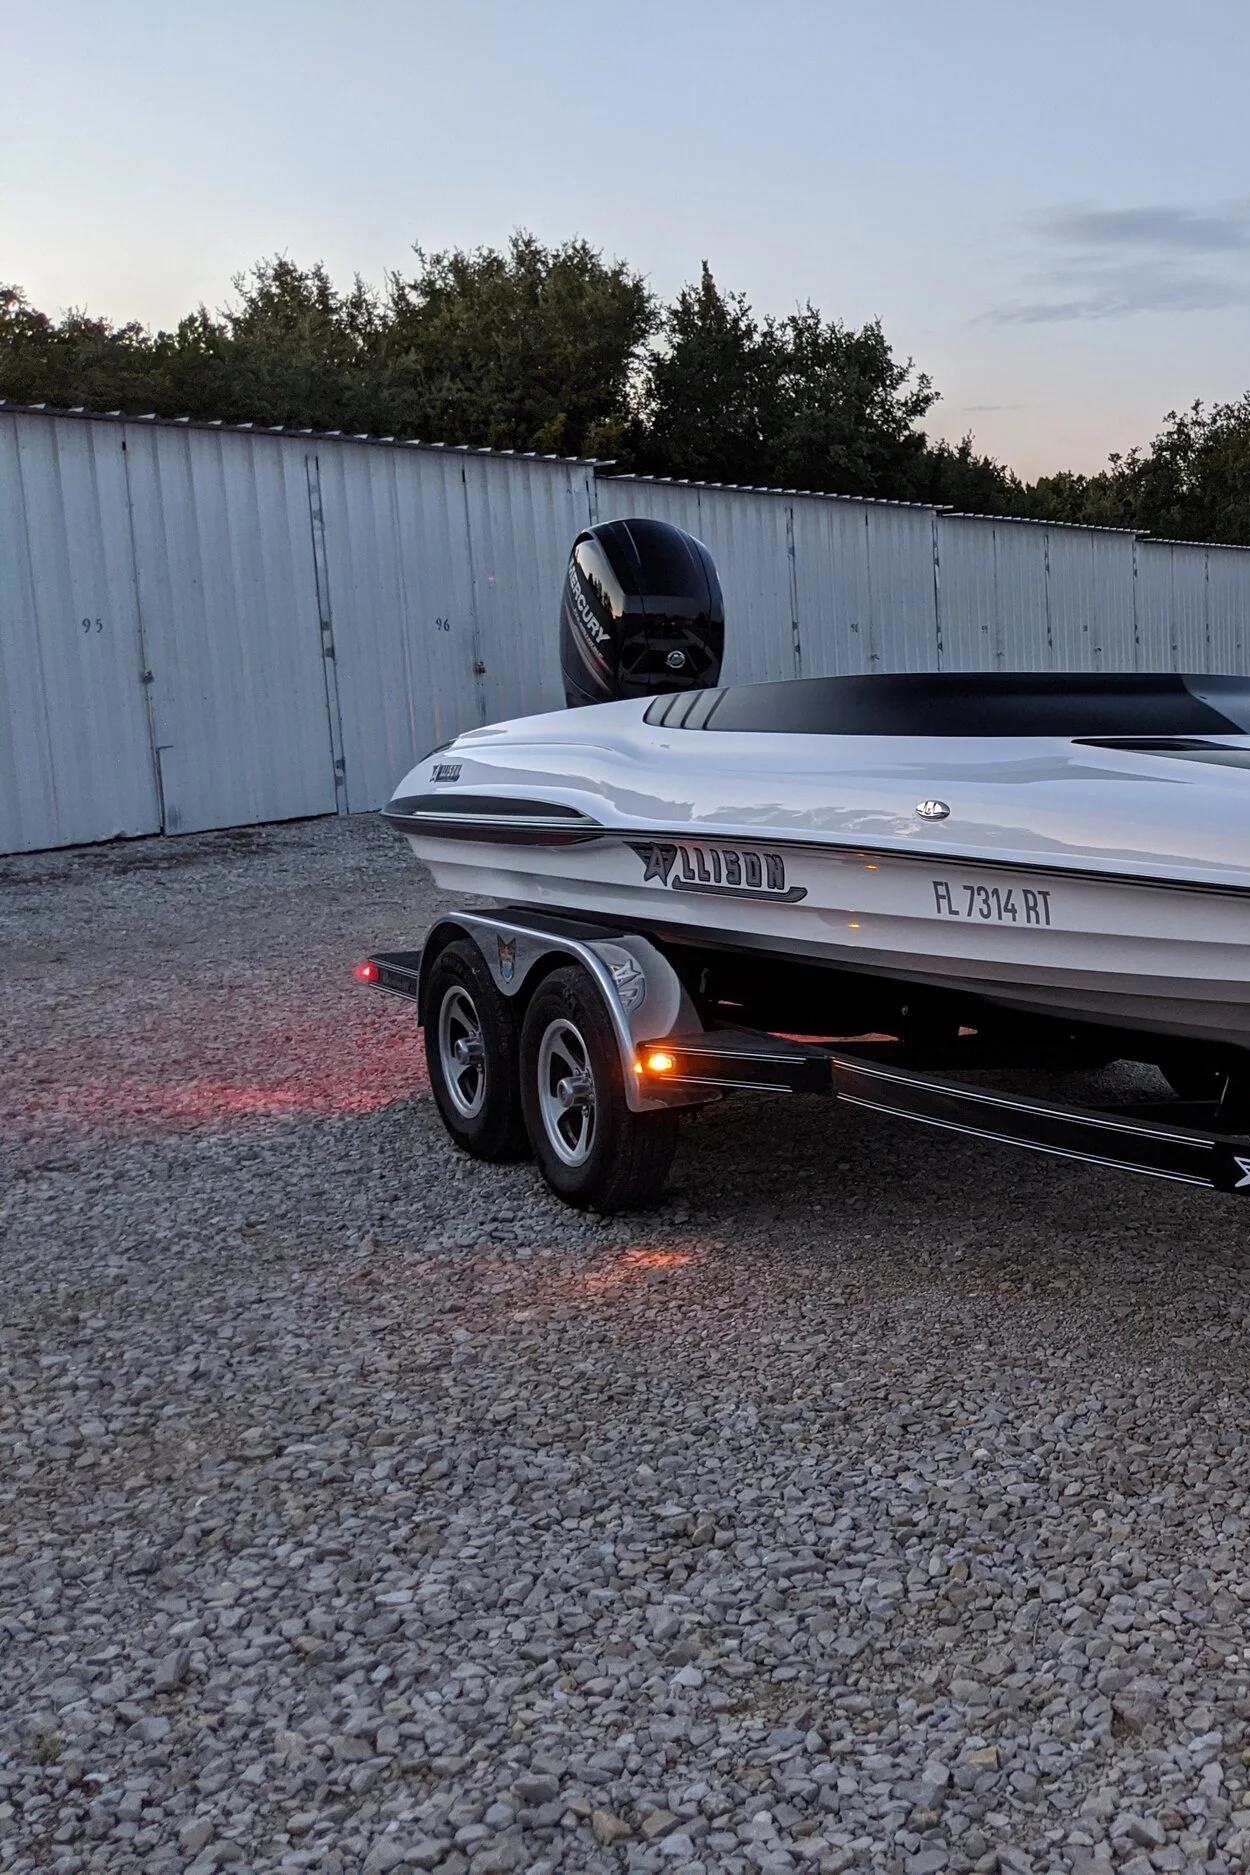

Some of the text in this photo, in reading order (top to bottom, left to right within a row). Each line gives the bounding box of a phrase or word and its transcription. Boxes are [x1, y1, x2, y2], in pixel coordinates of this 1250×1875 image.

[569, 558, 612, 643] MERCURY
[82, 618, 103, 633] 95
[435, 617, 450, 632] 96
[623, 841, 786, 890] ALLISON
[932, 880, 1051, 926] FL 7314 RT
